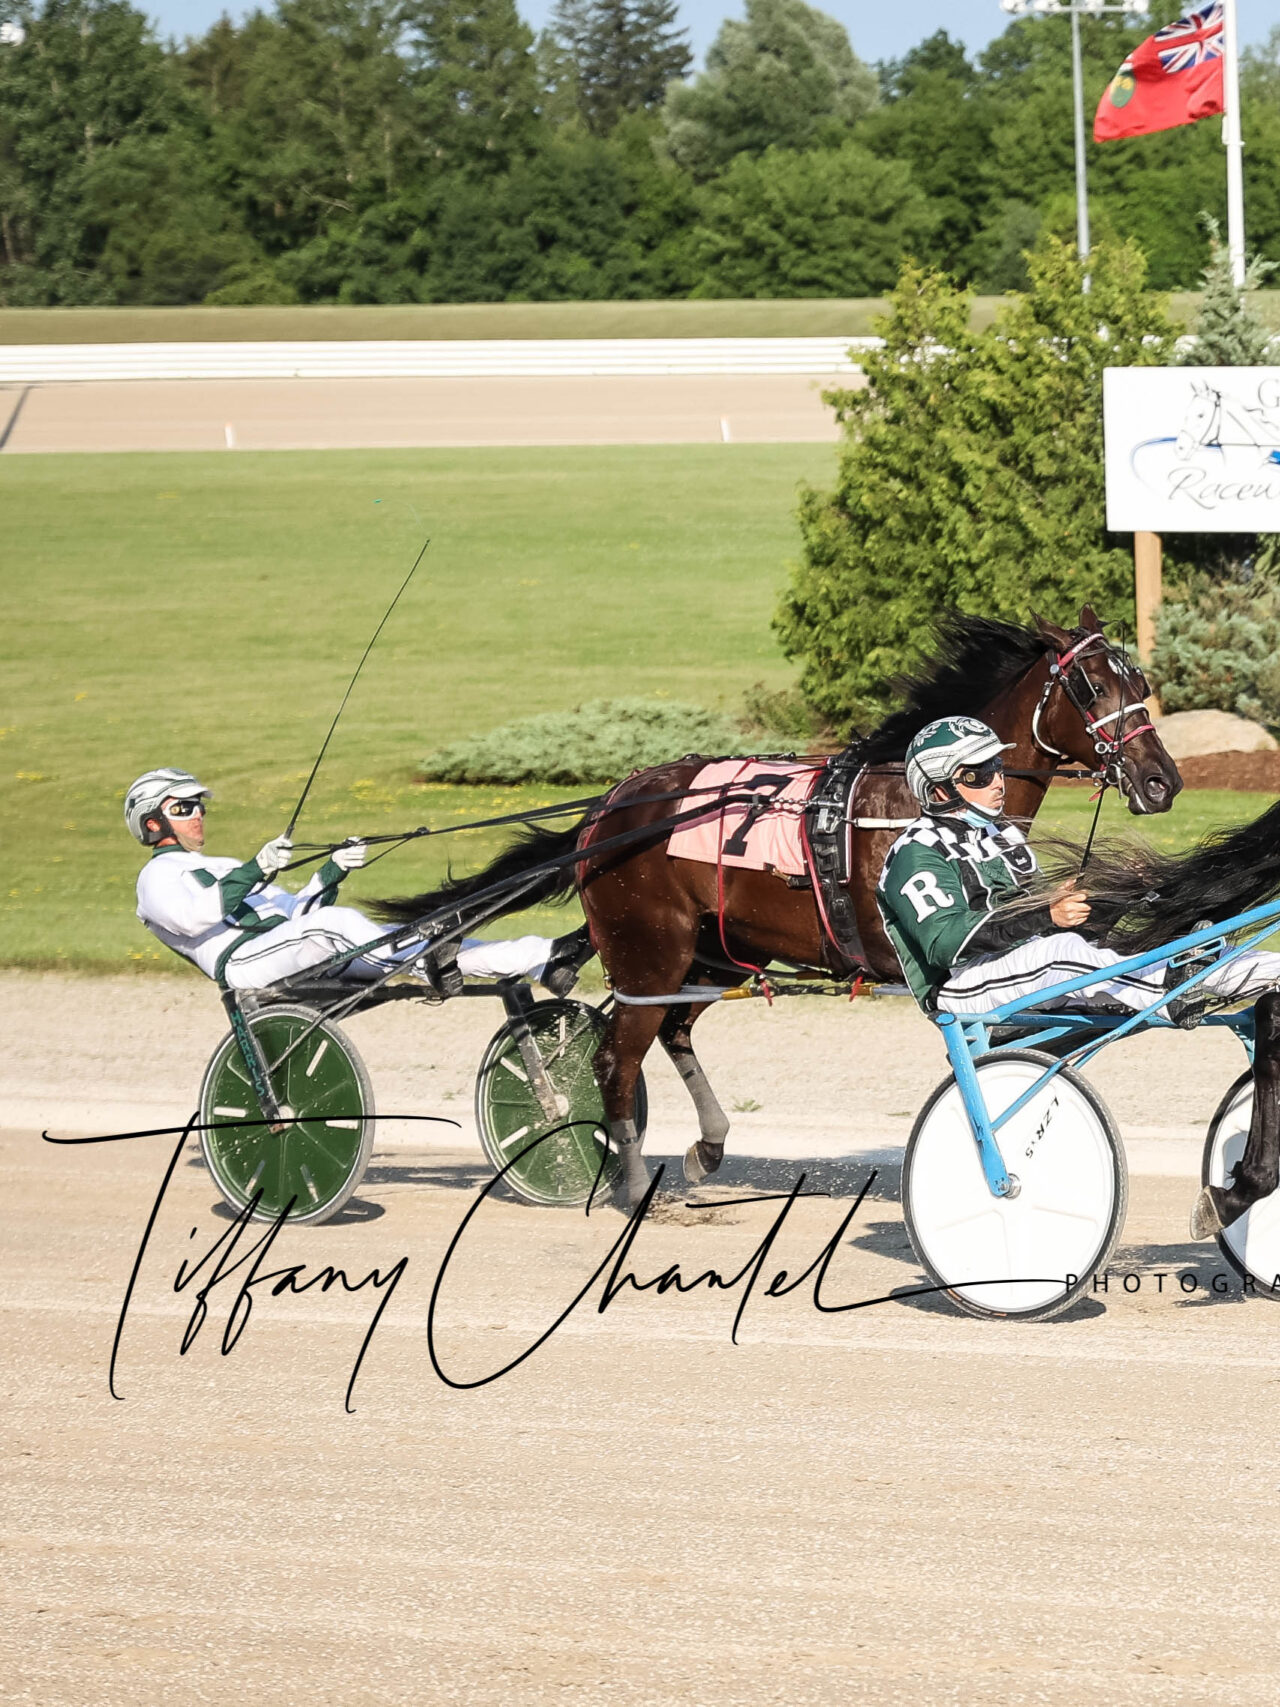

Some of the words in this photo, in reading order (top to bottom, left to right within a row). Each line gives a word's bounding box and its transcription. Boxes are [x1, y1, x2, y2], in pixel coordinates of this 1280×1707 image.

[721, 773, 797, 857] 7
[900, 870, 955, 924] R
[220, 1010, 266, 1097] HARRIS
